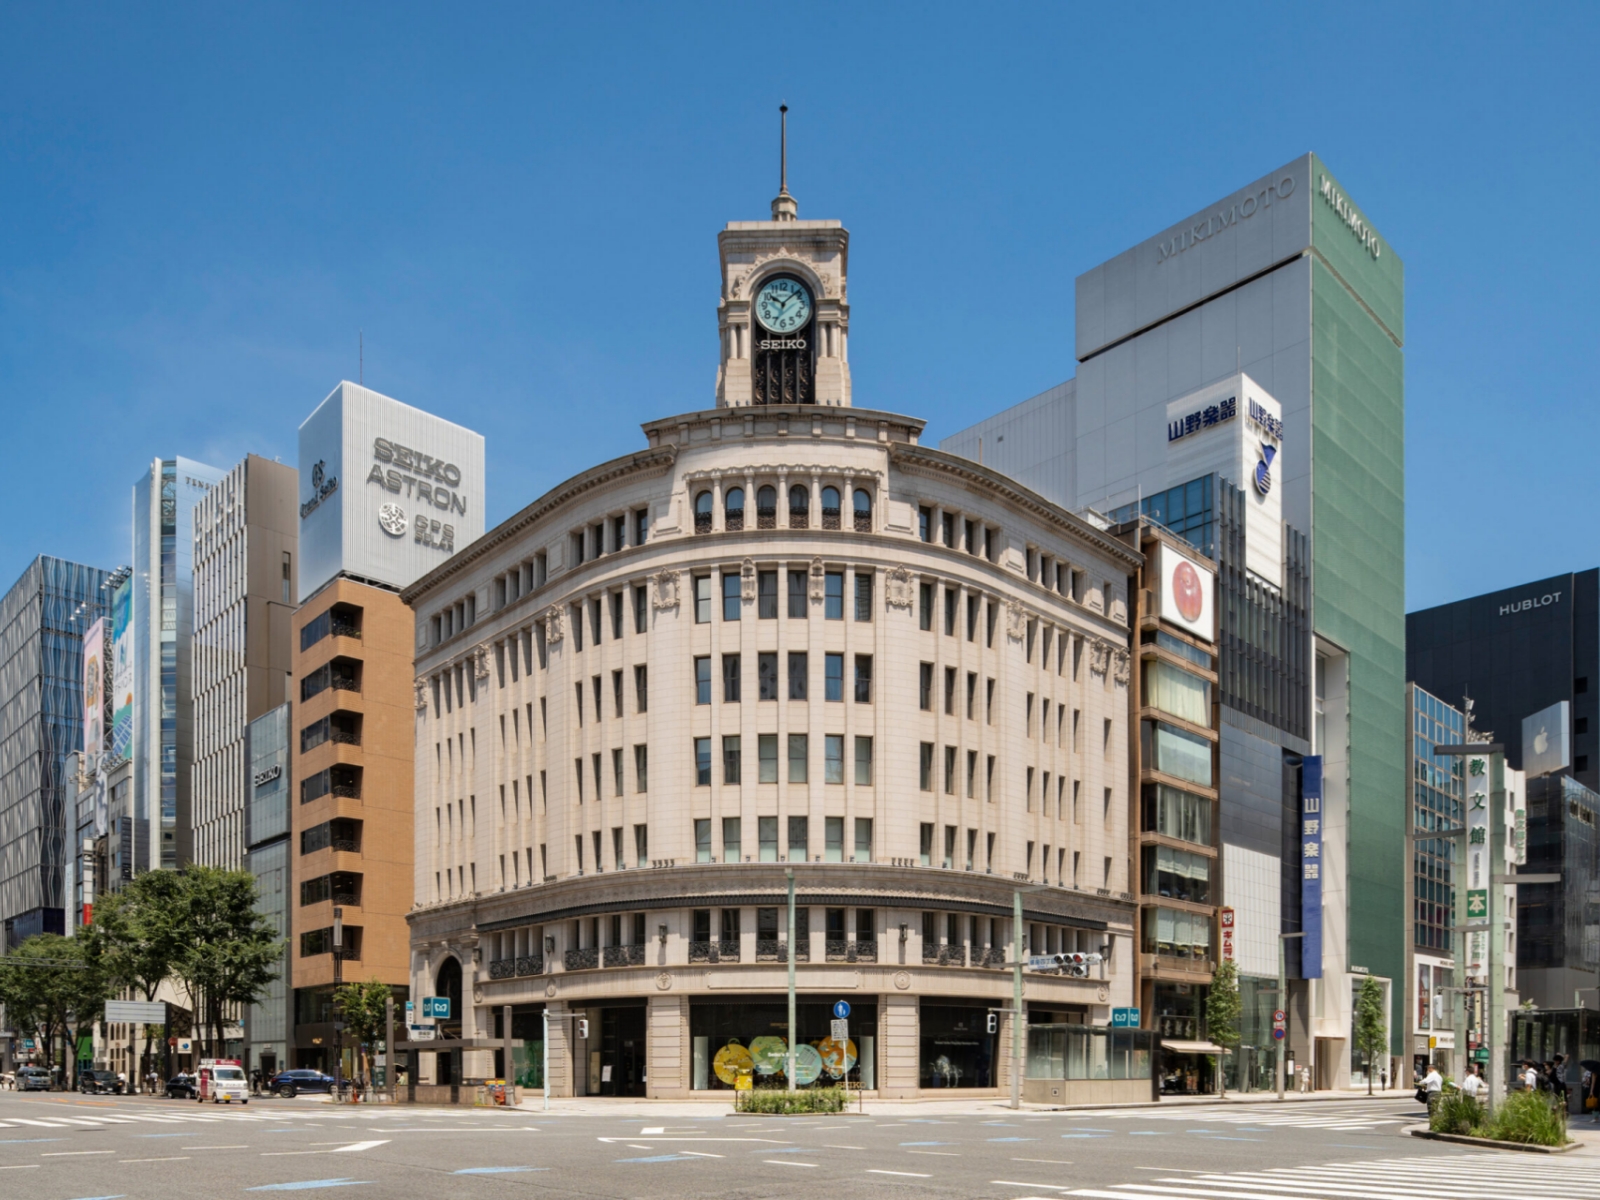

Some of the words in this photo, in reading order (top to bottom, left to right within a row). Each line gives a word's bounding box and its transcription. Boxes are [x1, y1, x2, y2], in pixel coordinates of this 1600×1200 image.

[1157, 177, 1296, 264] MIKIMOTO
[1320, 174, 1381, 258] MIKIMOTO
[771, 284, 778, 294] 11
[780, 282, 788, 292] 12
[790, 284, 795, 293] 1
[796, 290, 803, 300] 2
[764, 291, 771, 301] 10
[761, 301, 768, 311] 9
[799, 300, 805, 310] 3
[764, 310, 771, 320] 8
[772, 316, 779, 326] 7
[788, 316, 795, 326] 5
[795, 310, 802, 319] 4
[780, 318, 787, 328] 6
[760, 339, 807, 350] SEIKO
[1168, 396, 1236, 442] 山野楽器
[1249, 397, 1283, 441] 山野楽器
[374, 437, 461, 487] SEIKO
[366, 464, 467, 516] ASTRON
[415, 514, 454, 541] GPS
[414, 532, 454, 554] SOLAR
[1499, 591, 1562, 616] HUBLOT
[254, 764, 281, 787] SEIKO
[1469, 758, 1486, 845] 教文館
[1304, 798, 1319, 879] 山野楽器
[1469, 893, 1486, 914] 本
